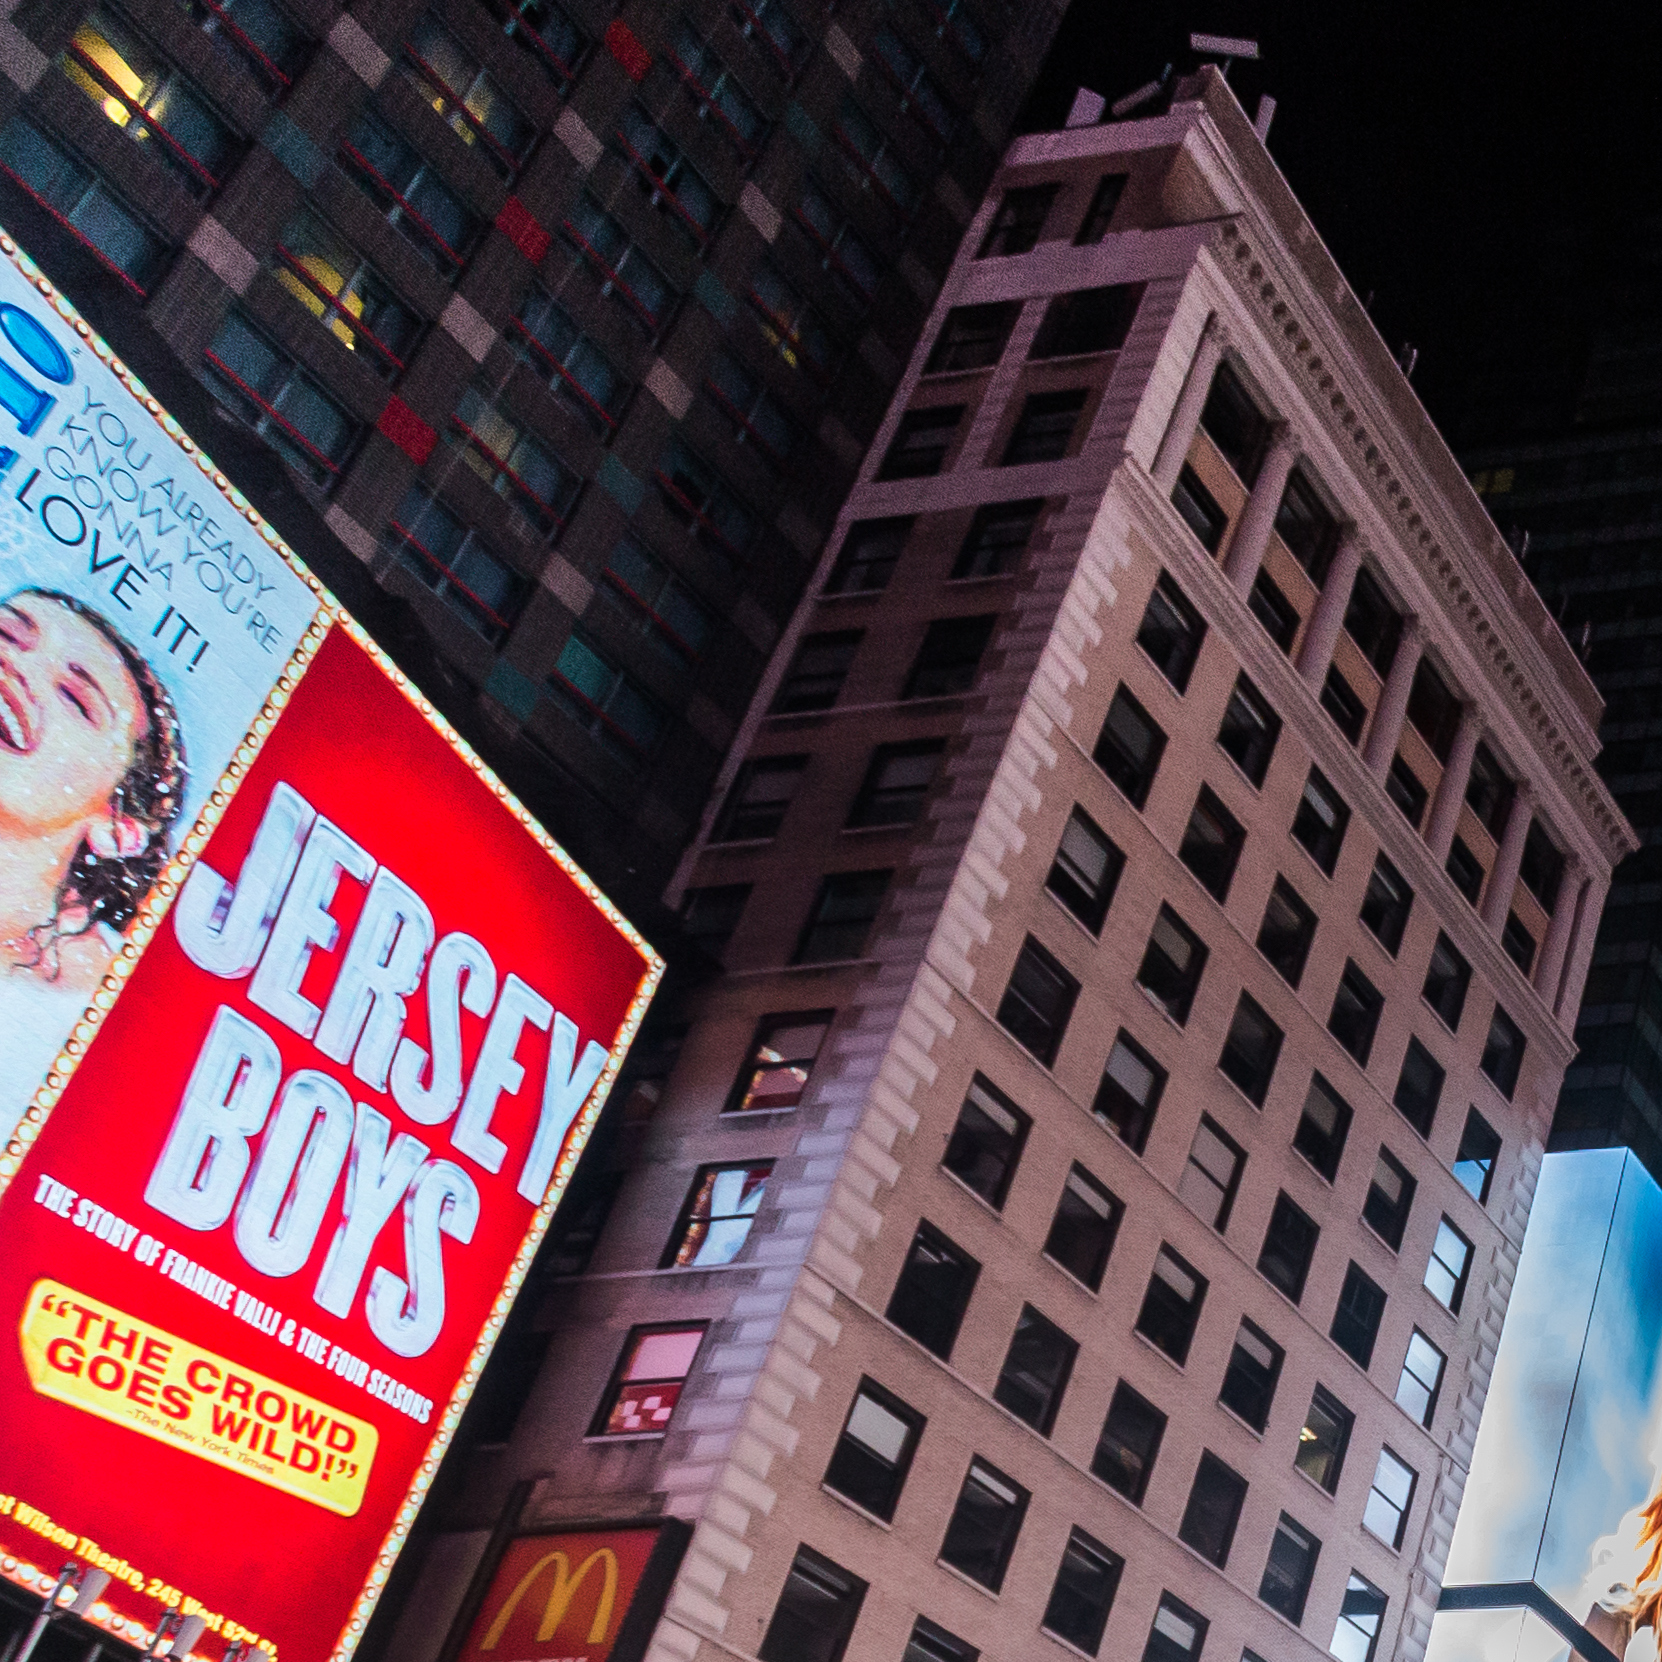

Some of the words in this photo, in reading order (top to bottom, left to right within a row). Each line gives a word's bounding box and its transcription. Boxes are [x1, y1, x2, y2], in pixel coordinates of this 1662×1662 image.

[15, 468, 149, 612] LOVE
[153, 605, 209, 673] IT!
[44, 446, 173, 592] GONNA
[60, 415, 179, 536] KNOW
[182, 536, 284, 654] YOU'RE
[80, 385, 152, 470] YOU
[152, 477, 277, 599] ALREADY
[174, 780, 610, 1208] JERSEY
[143, 1004, 481, 1358] BOYS
[33, 1173, 77, 1221] THE
[73, 1196, 140, 1255] STORY
[134, 1232, 167, 1264] OF
[159, 1248, 237, 1311] FRANKIE
[232, 1285, 283, 1335] VALLI
[277, 1318, 299, 1346] &
[295, 1326, 331, 1367] THE
[326, 1347, 370, 1389] FOUR
[365, 1369, 435, 1424] SEASONS
[44, 1336, 193, 1422] GOES
[162, 1421, 195, 1445] New
[199, 1437, 231, 1460] York
[236, 1450, 275, 1476] Times
[185, 1359, 358, 1456] CROWD
[14, 1503, 78, 1549] Wilson
[75, 1536, 146, 1593] Theatre,
[147, 1577, 183, 1610] 245
